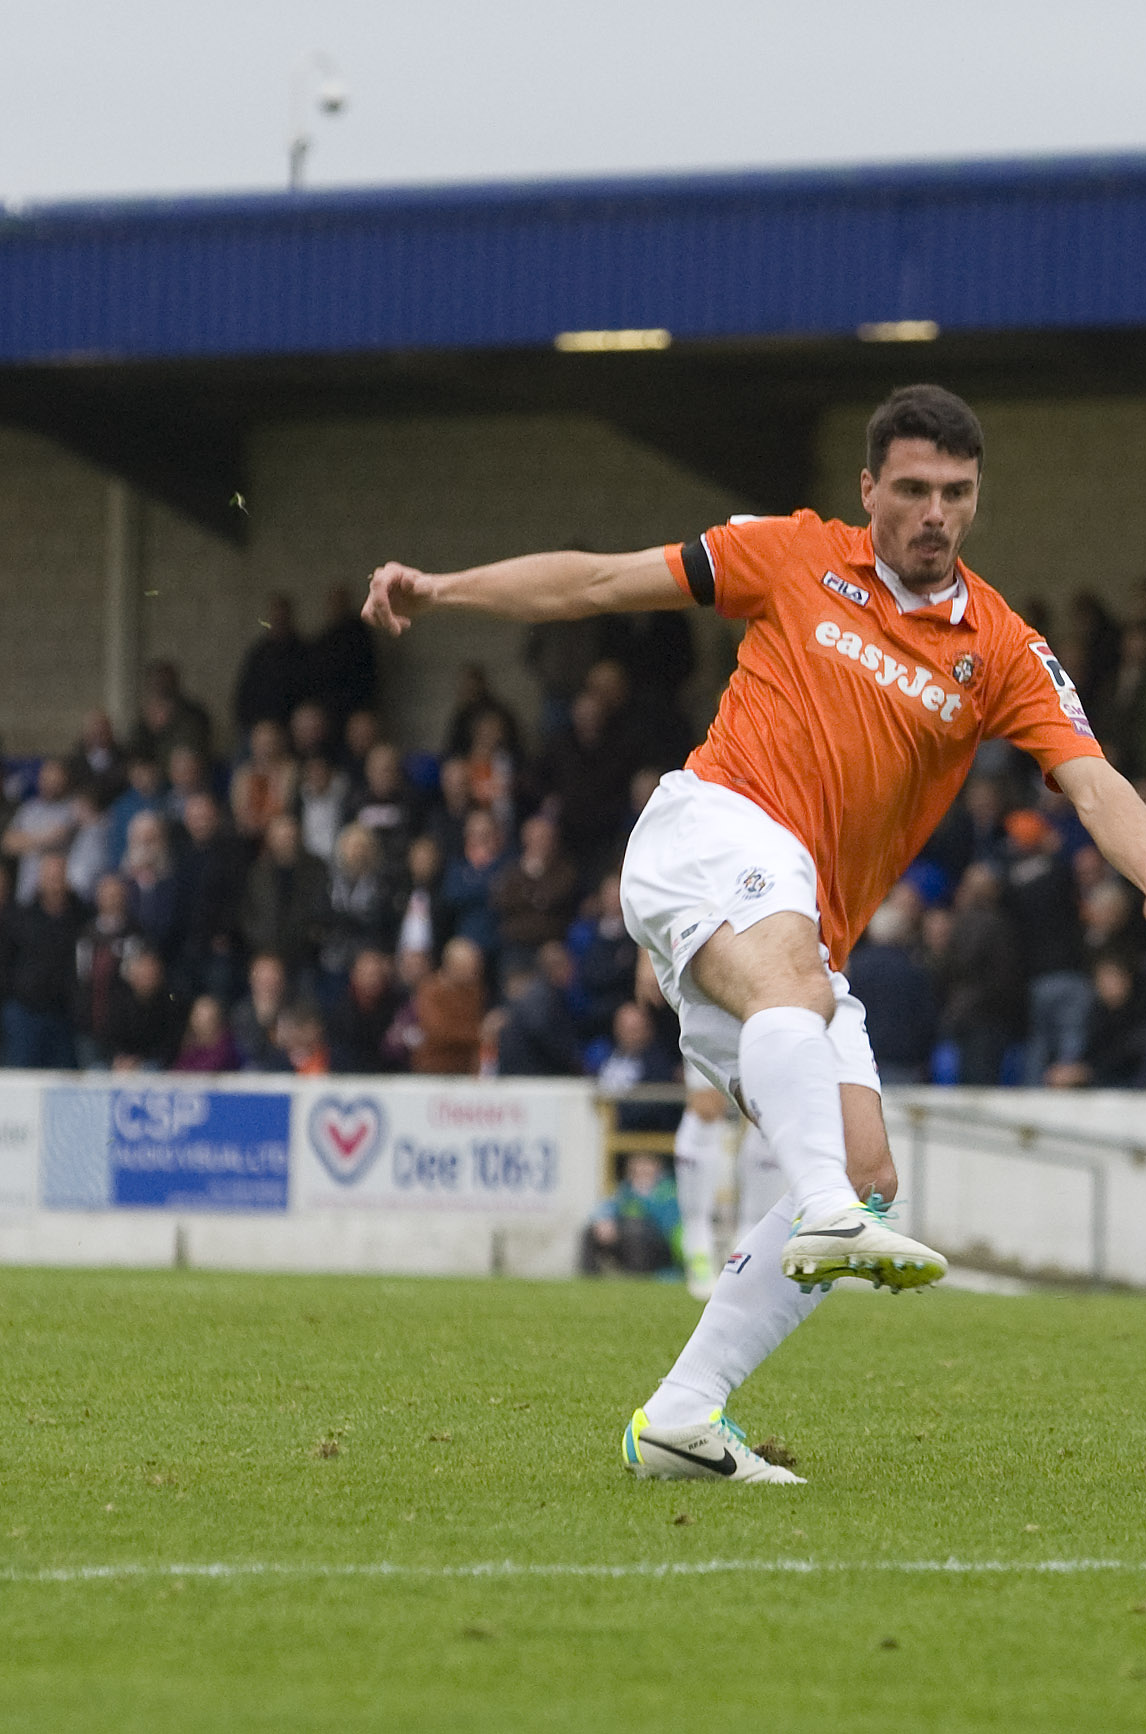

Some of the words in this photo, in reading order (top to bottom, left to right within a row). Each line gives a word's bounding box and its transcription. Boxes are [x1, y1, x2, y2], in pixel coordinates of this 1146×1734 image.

[825, 574, 865, 603] FILA
[815, 621, 962, 722] easyJet
[115, 1085, 210, 1141] CSP
[392, 1137, 459, 1190] Dee
